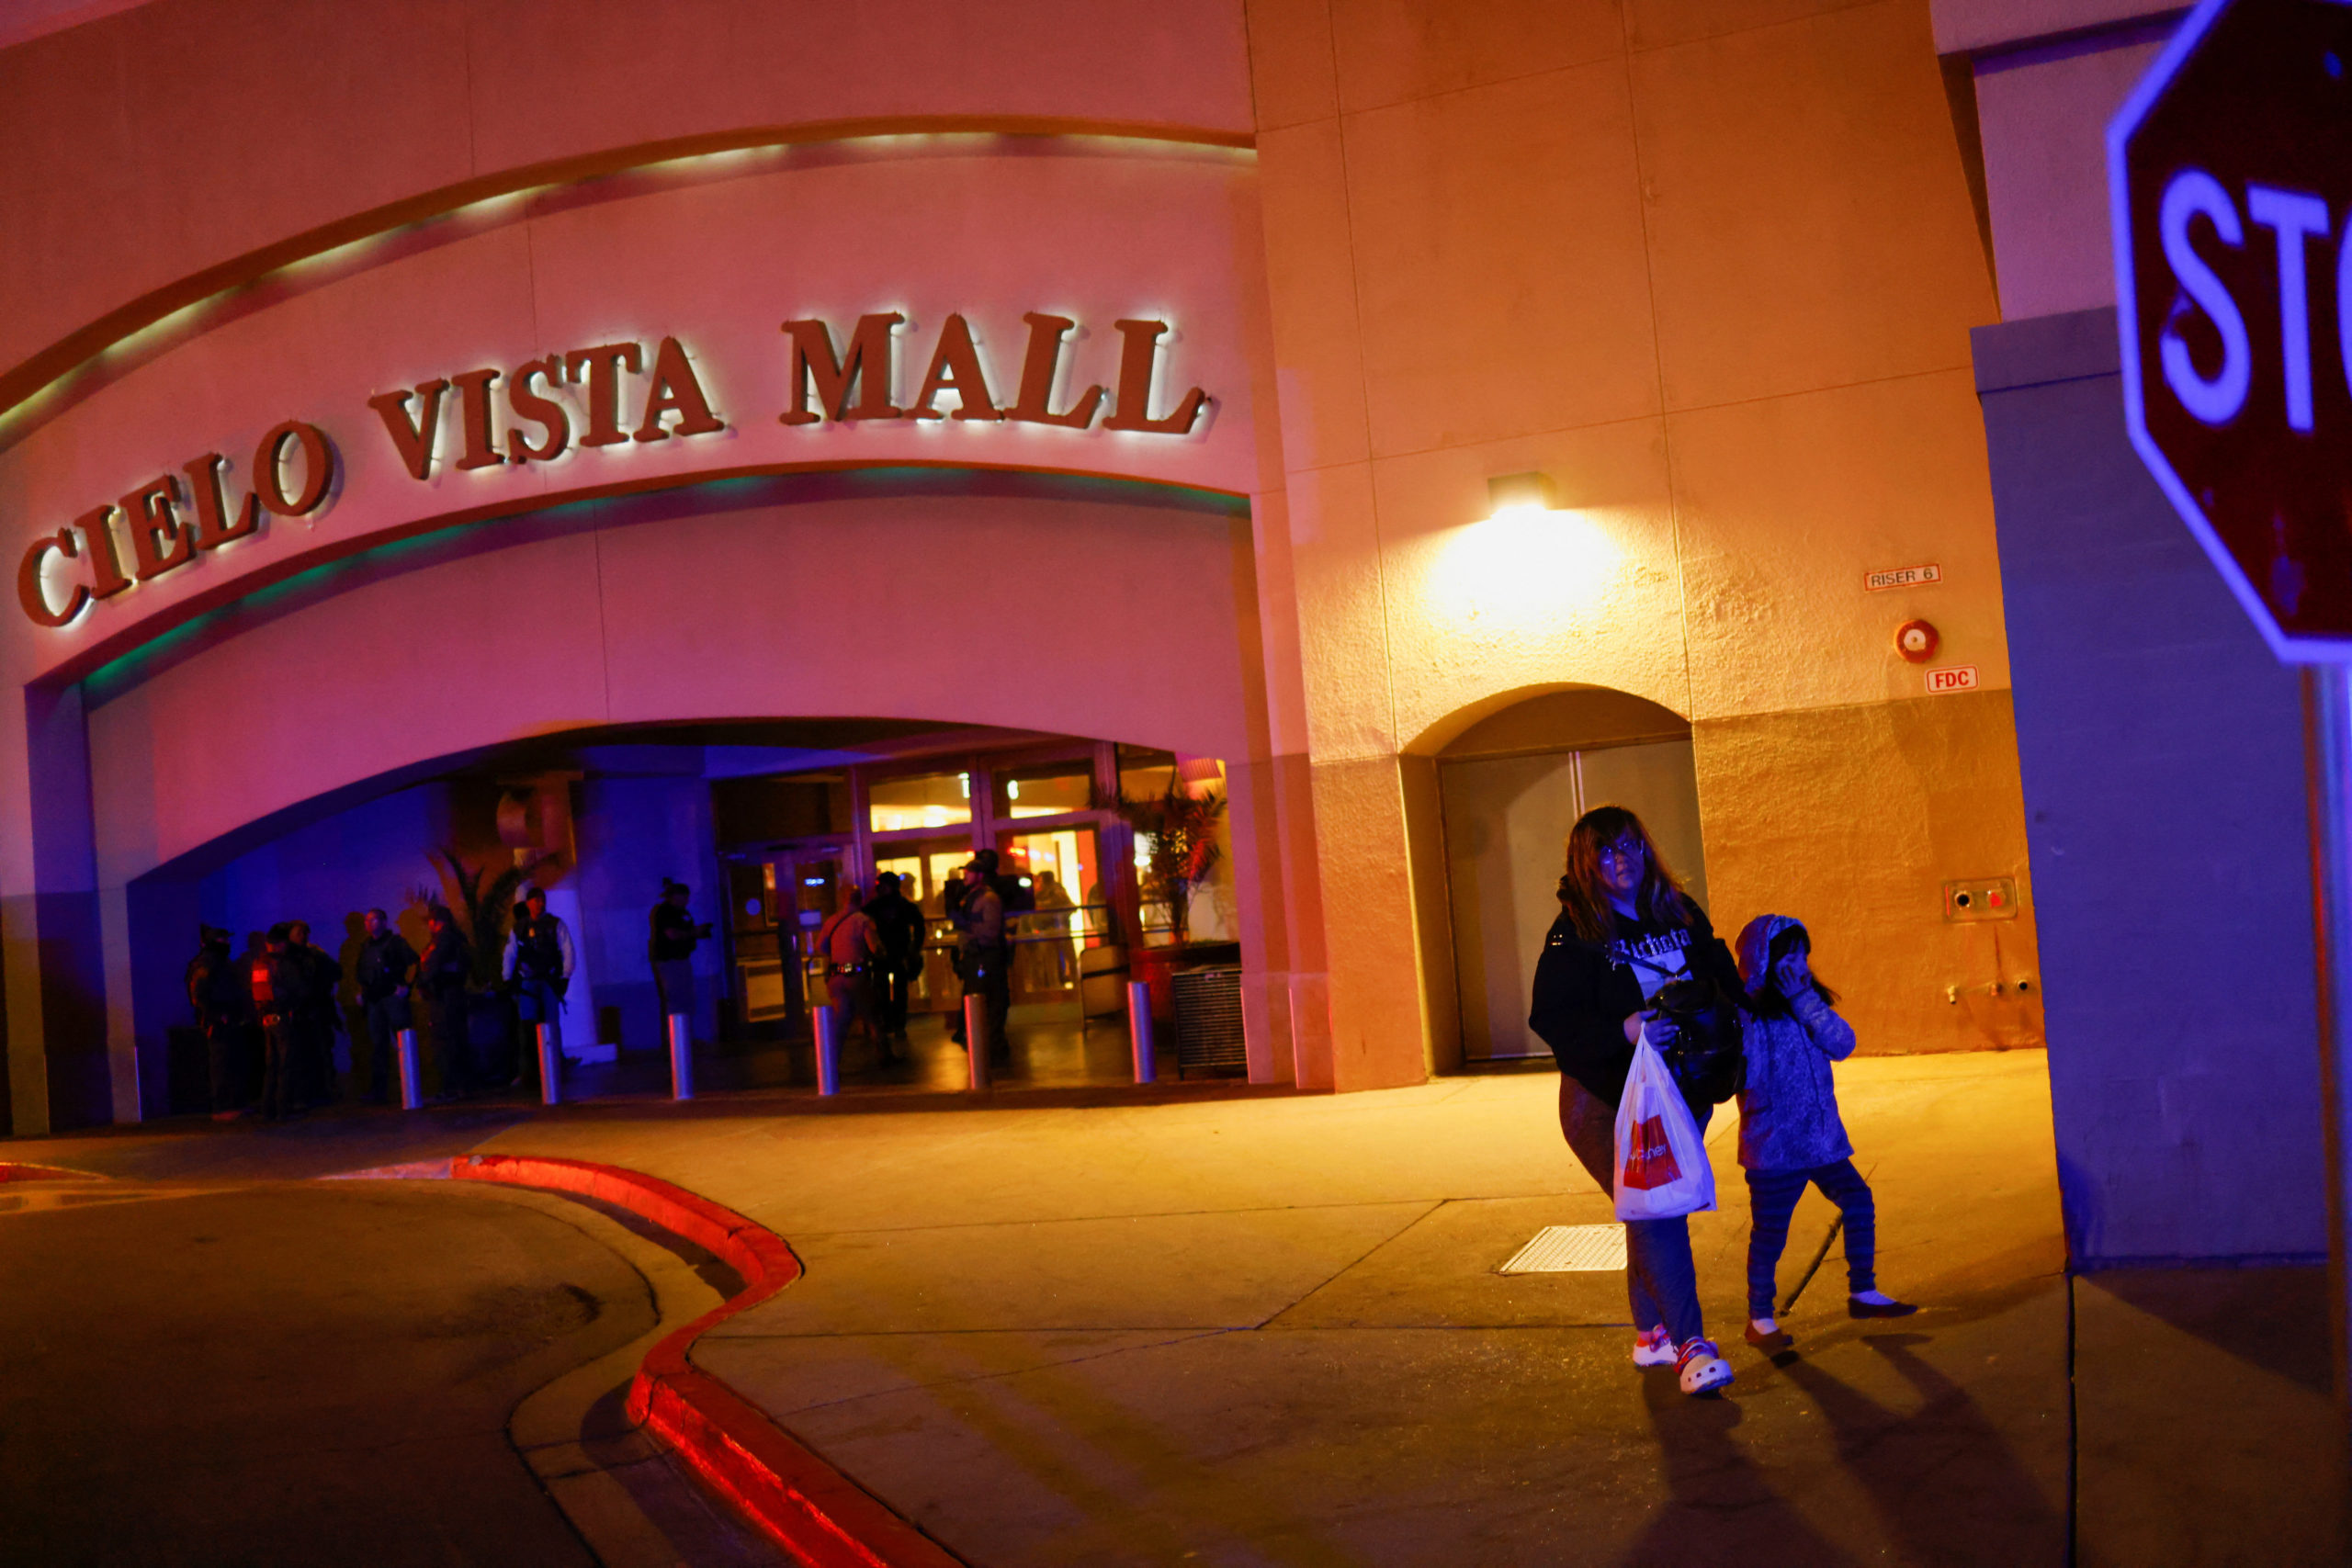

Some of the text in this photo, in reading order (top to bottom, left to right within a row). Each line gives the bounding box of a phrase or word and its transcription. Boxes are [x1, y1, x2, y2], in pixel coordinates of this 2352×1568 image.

[2159, 166, 2352, 434] ST
[17, 311, 1209, 626] CIELO VISTA MALL
[1871, 568, 1933, 587] RISER 6
[1934, 671, 1970, 689] FDC
